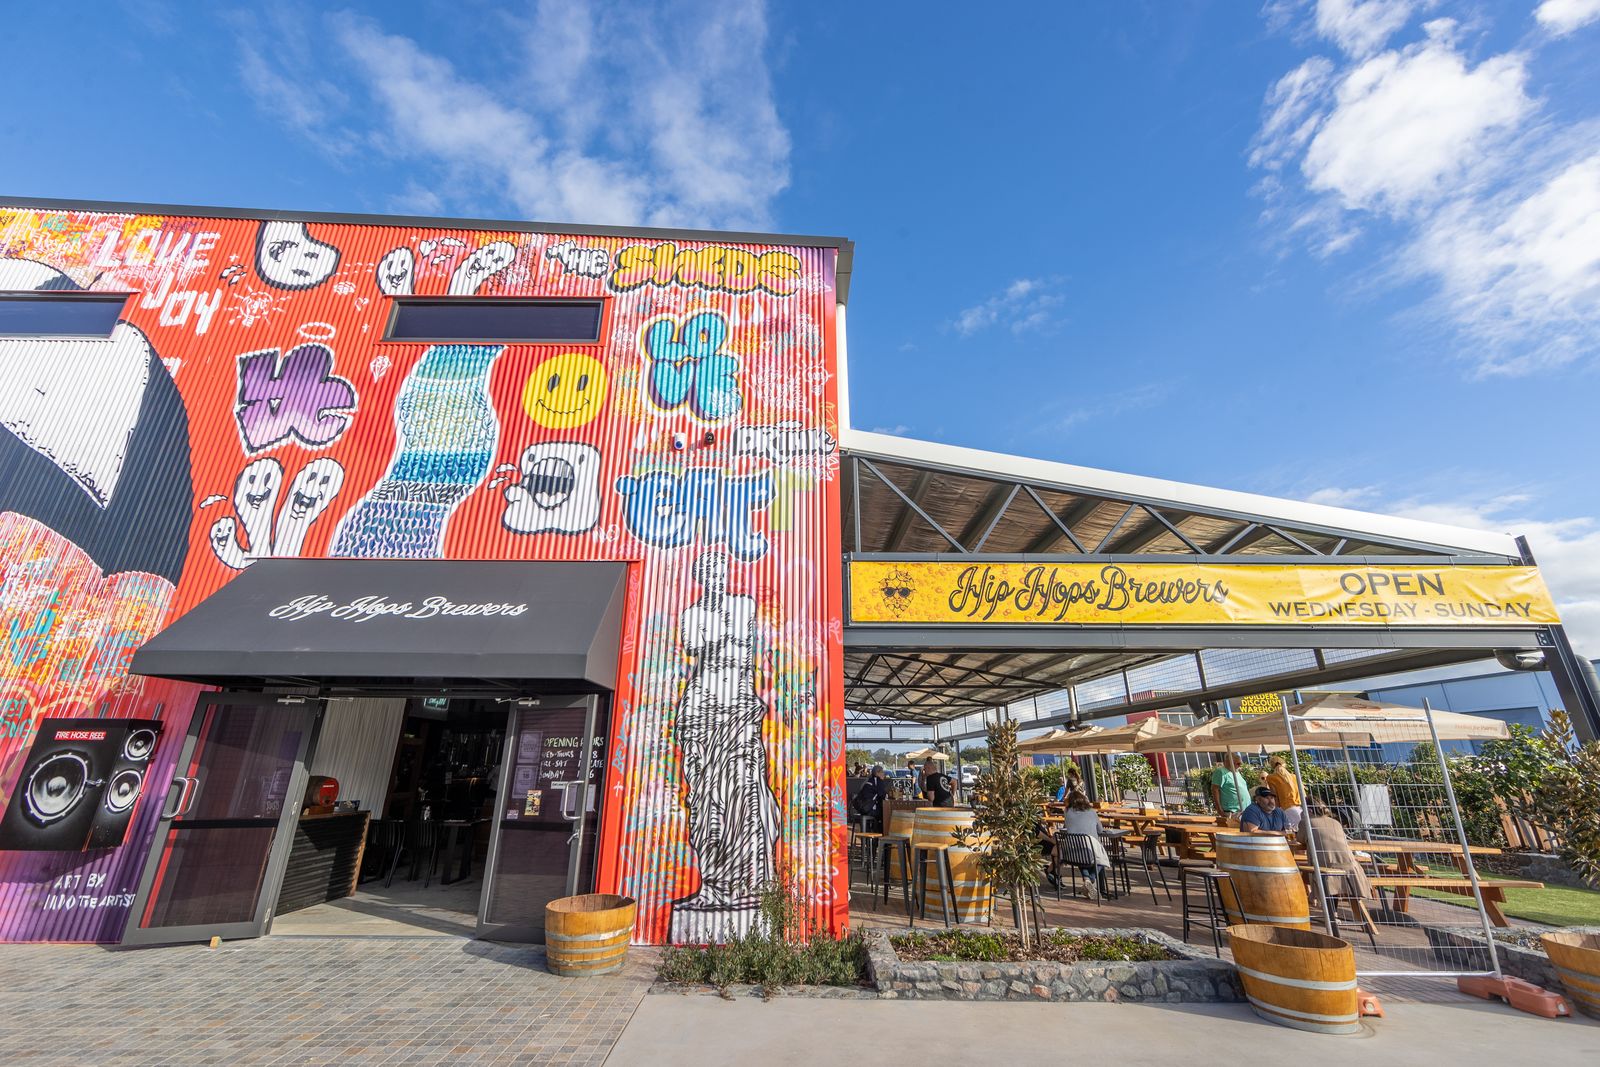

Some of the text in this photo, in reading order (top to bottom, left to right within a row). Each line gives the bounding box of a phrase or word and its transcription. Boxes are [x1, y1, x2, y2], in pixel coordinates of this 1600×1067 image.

[93, 228, 221, 269] LOVE
[140, 270, 222, 336] JOY
[949, 566, 1229, 621] Hip Hops Brewers
[1339, 573, 1446, 596] OPEN
[268, 594, 528, 623] Hip Hops Brewers
[1268, 602, 1417, 617] WEDNESDAY
[1434, 602, 1531, 618] SUNDAY
[55, 731, 105, 740] FIRE HOSE REEL
[544, 737, 579, 748] OPENING
[54, 874, 82, 889] ART
